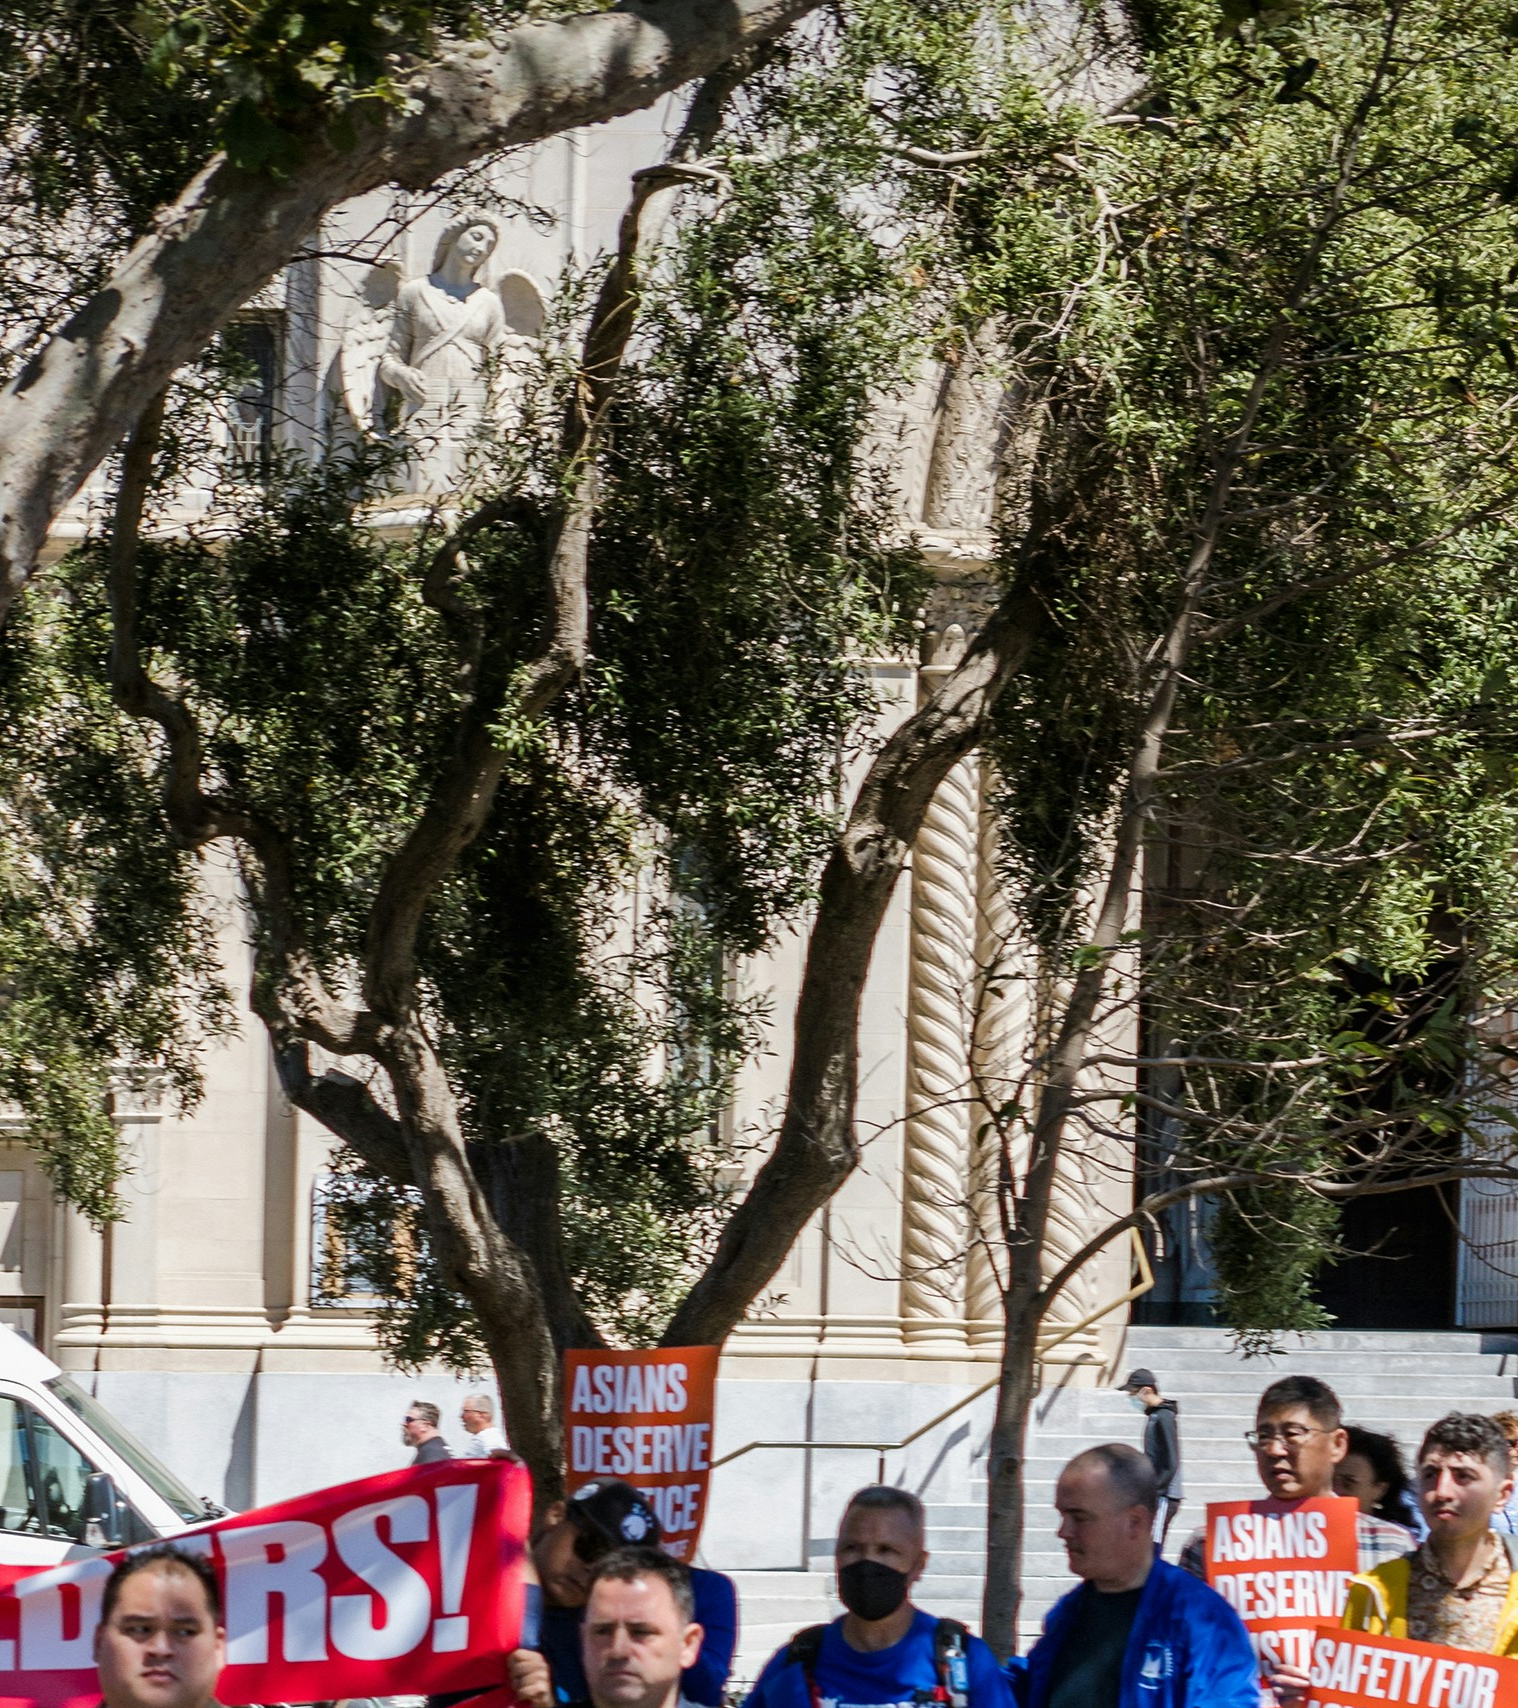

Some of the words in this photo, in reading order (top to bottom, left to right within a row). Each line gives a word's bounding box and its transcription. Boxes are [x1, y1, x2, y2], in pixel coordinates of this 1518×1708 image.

[572, 1363, 688, 1413] ASIANS
[572, 1423, 711, 1475] DESERVE
[1212, 1511, 1329, 1563] ASIANS
[1310, 1638, 1431, 1705] SAFETY
